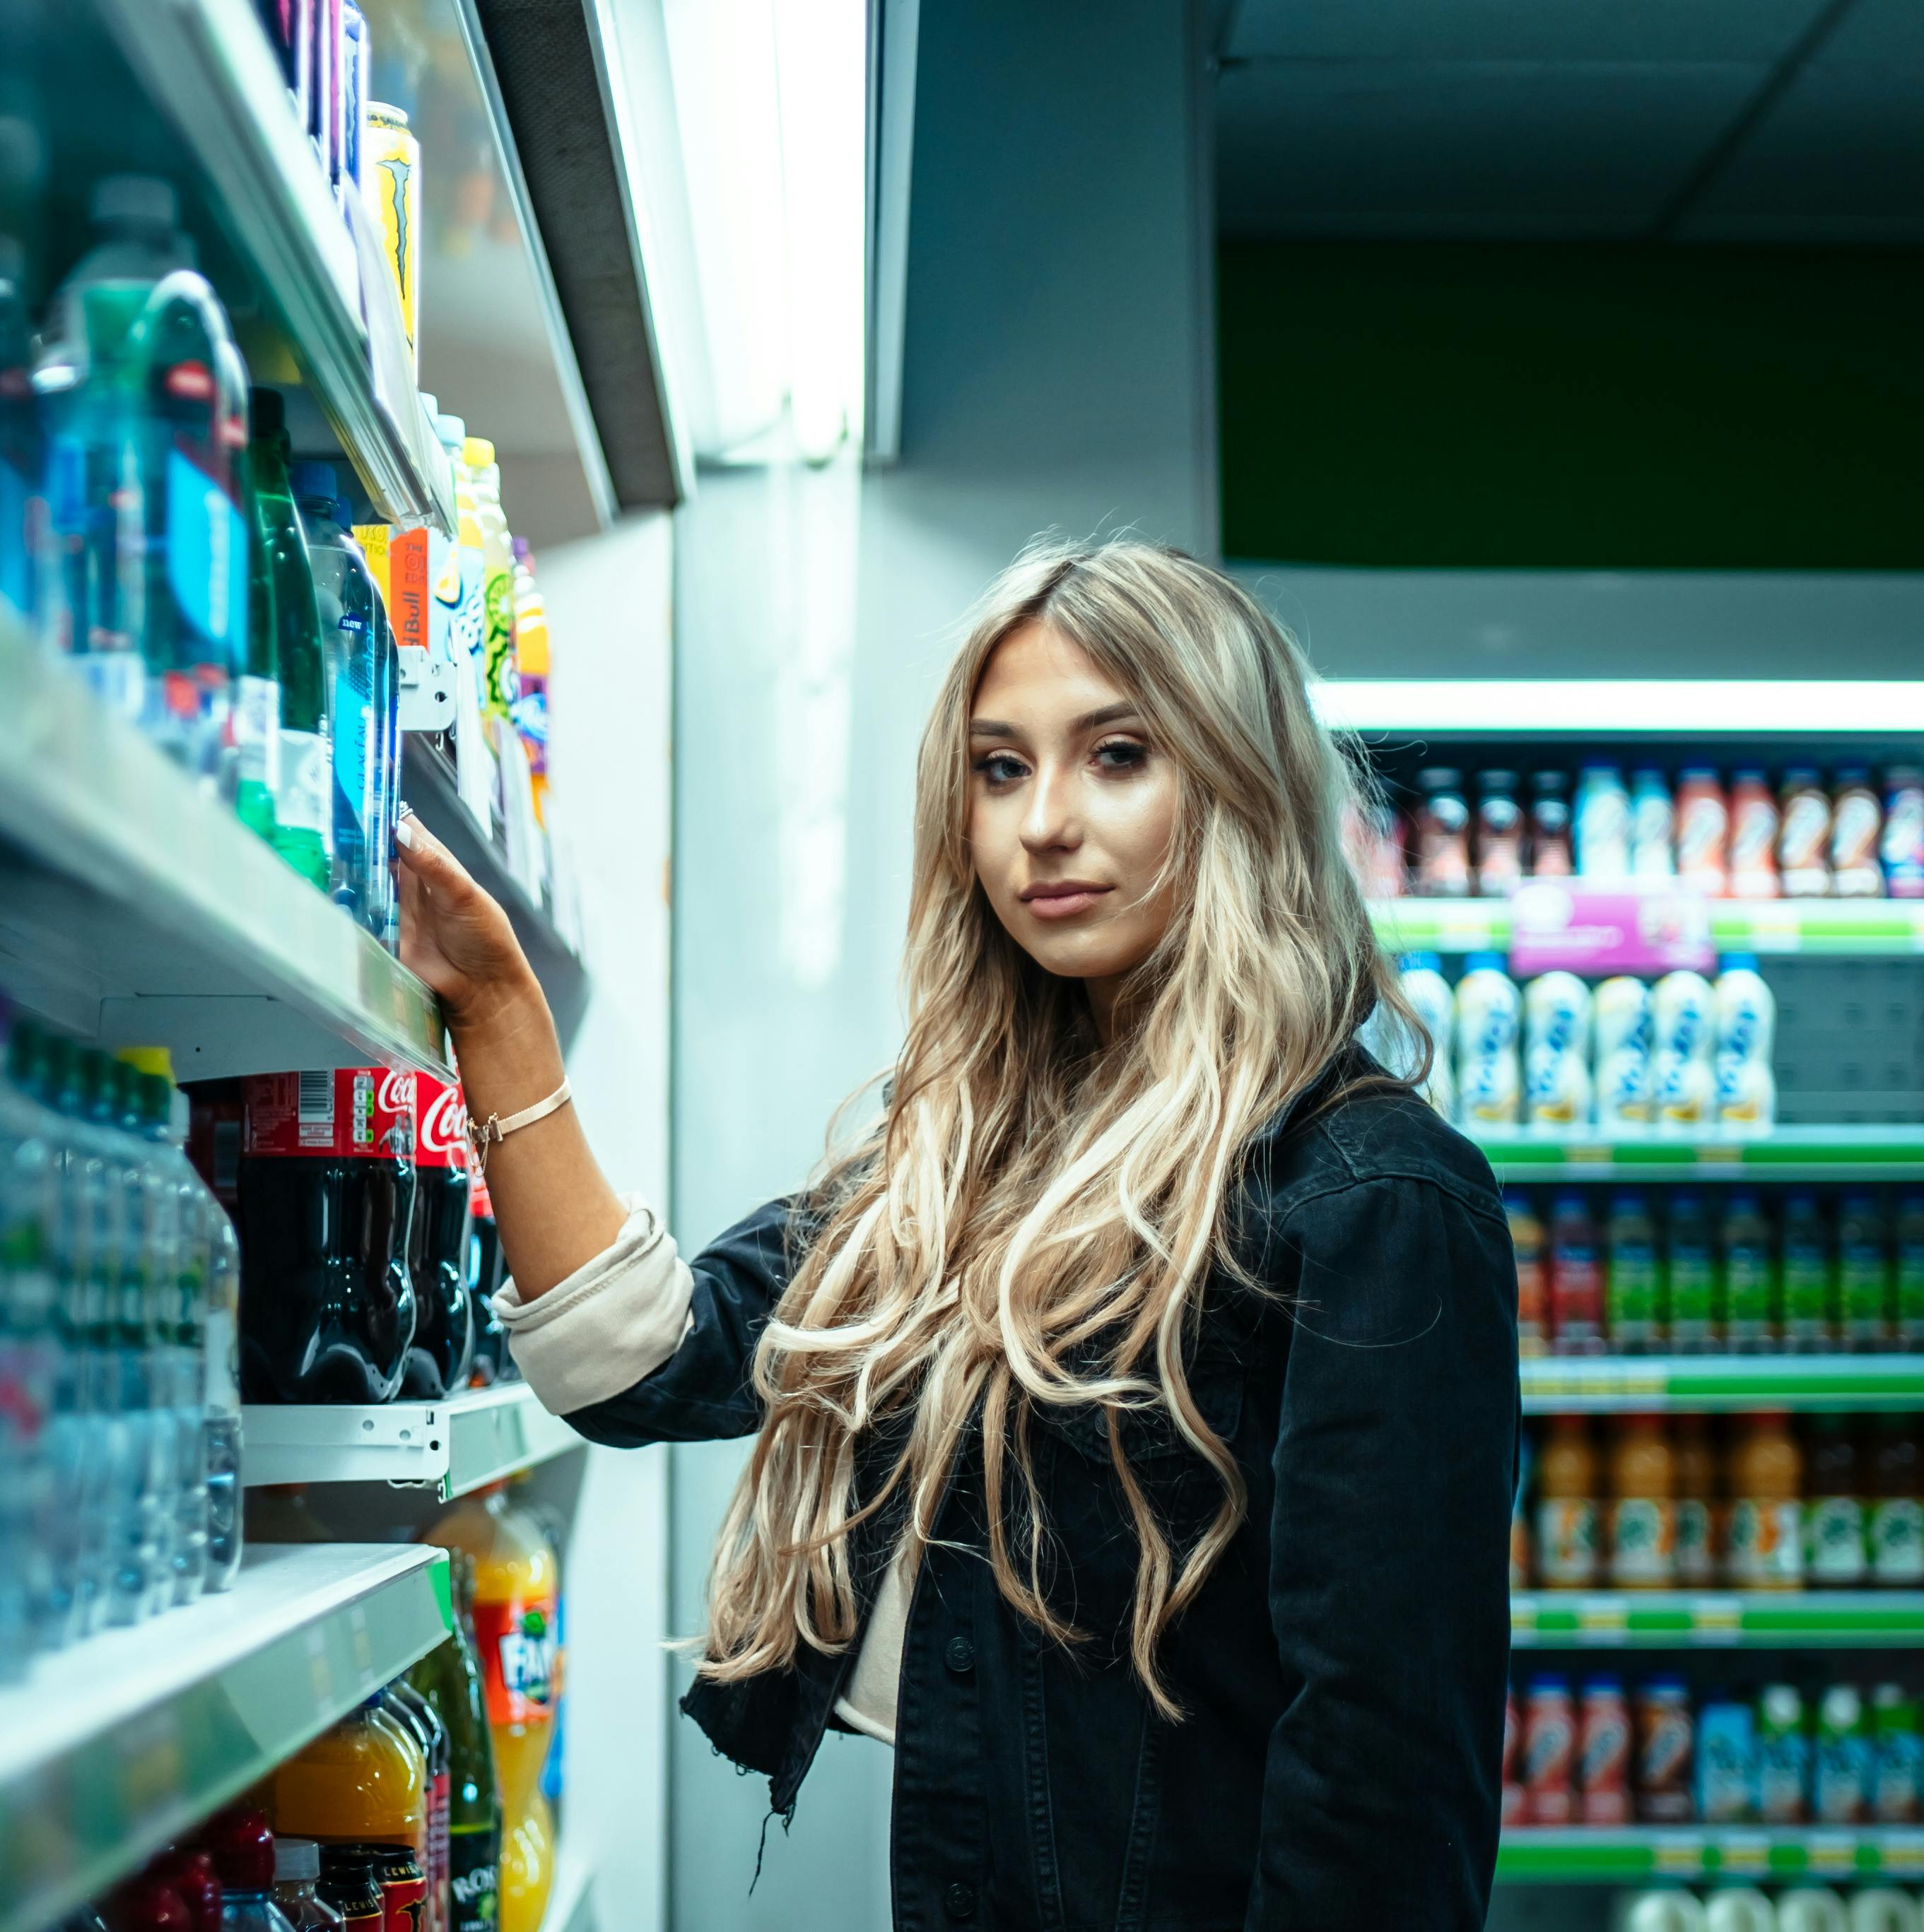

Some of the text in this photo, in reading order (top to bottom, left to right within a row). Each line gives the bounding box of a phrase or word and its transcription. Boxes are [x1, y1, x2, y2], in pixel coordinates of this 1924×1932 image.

[403, 591, 419, 633] Bull
[342, 618, 363, 630] new
[344, 1899, 374, 1912] LEWIS
